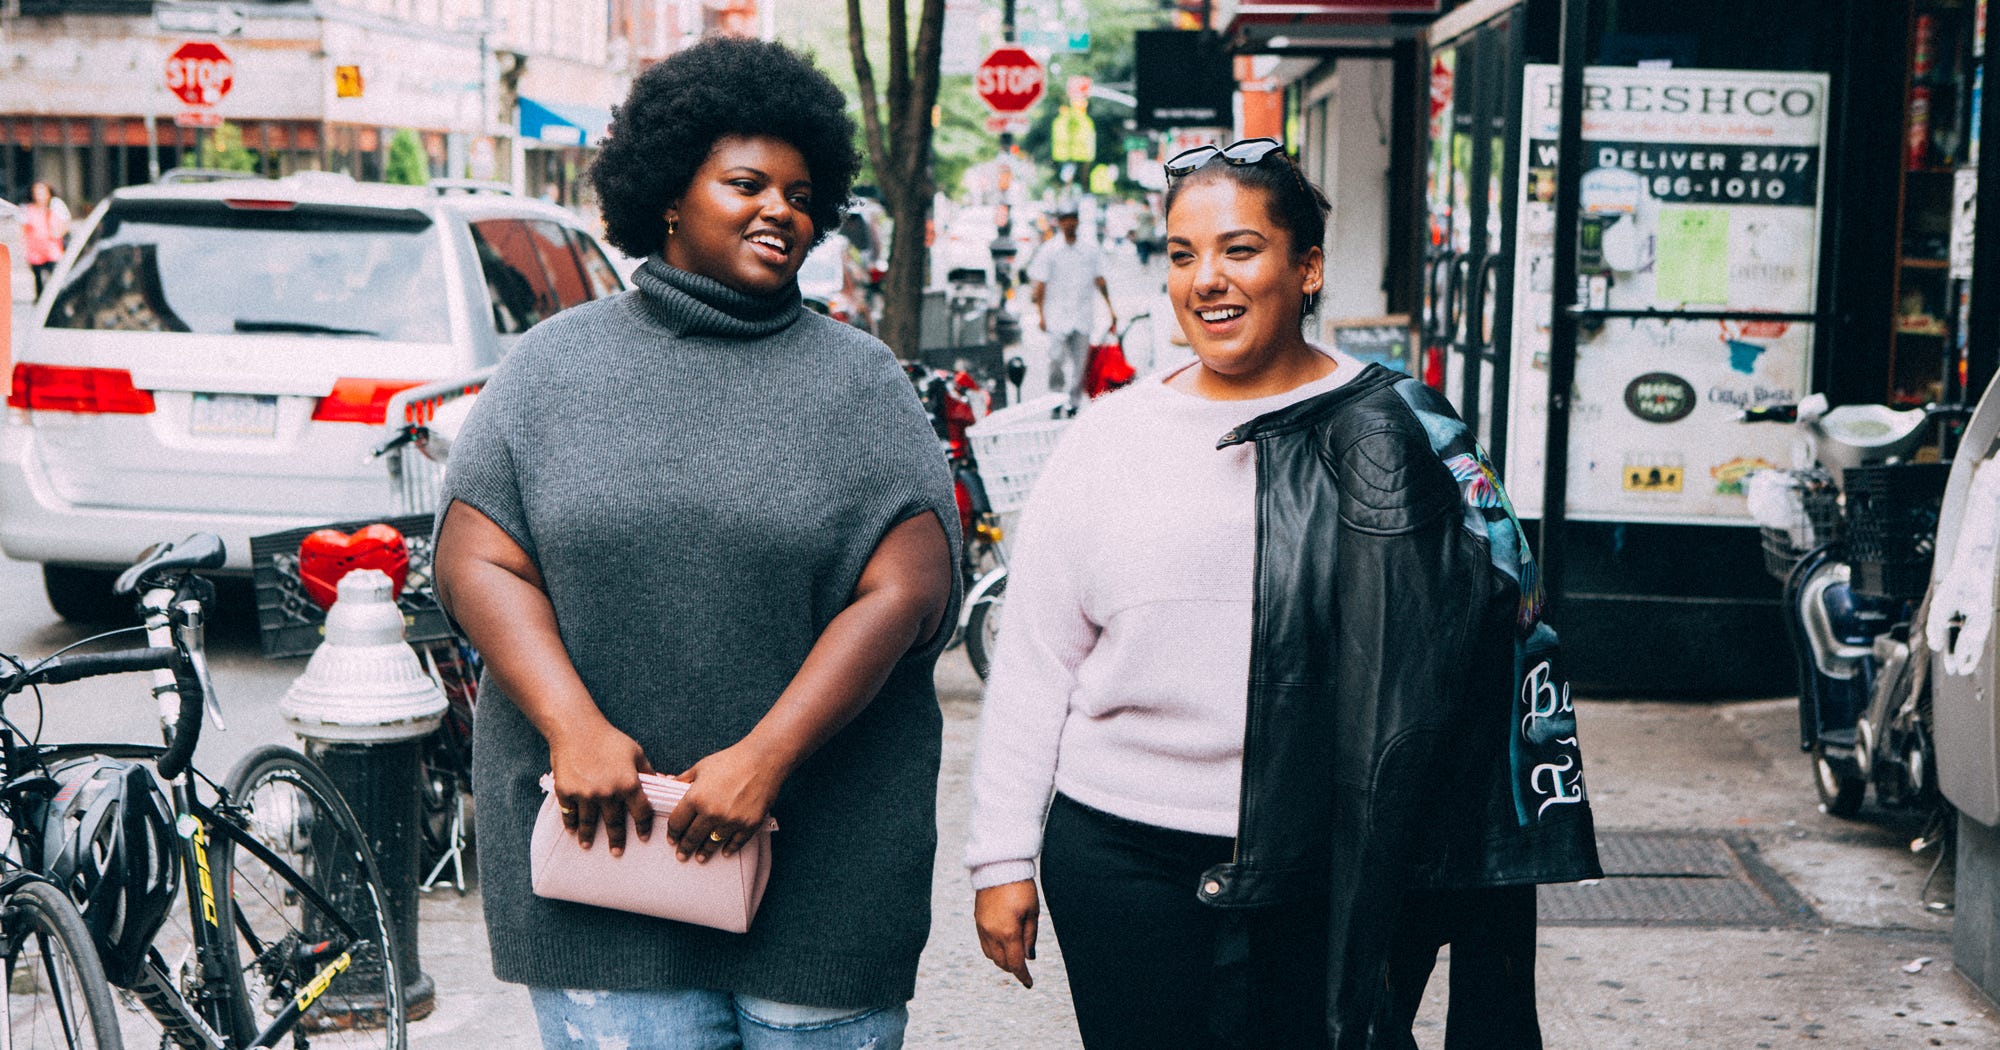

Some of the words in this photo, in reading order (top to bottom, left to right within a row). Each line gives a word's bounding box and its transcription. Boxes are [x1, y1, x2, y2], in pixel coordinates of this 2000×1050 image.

[166, 57, 234, 90] STOP
[979, 66, 1042, 95] STOP
[1598, 147, 1726, 171] DELIVER
[1740, 151, 1809, 173] 24/7
[294, 951, 351, 1012] DEFY
